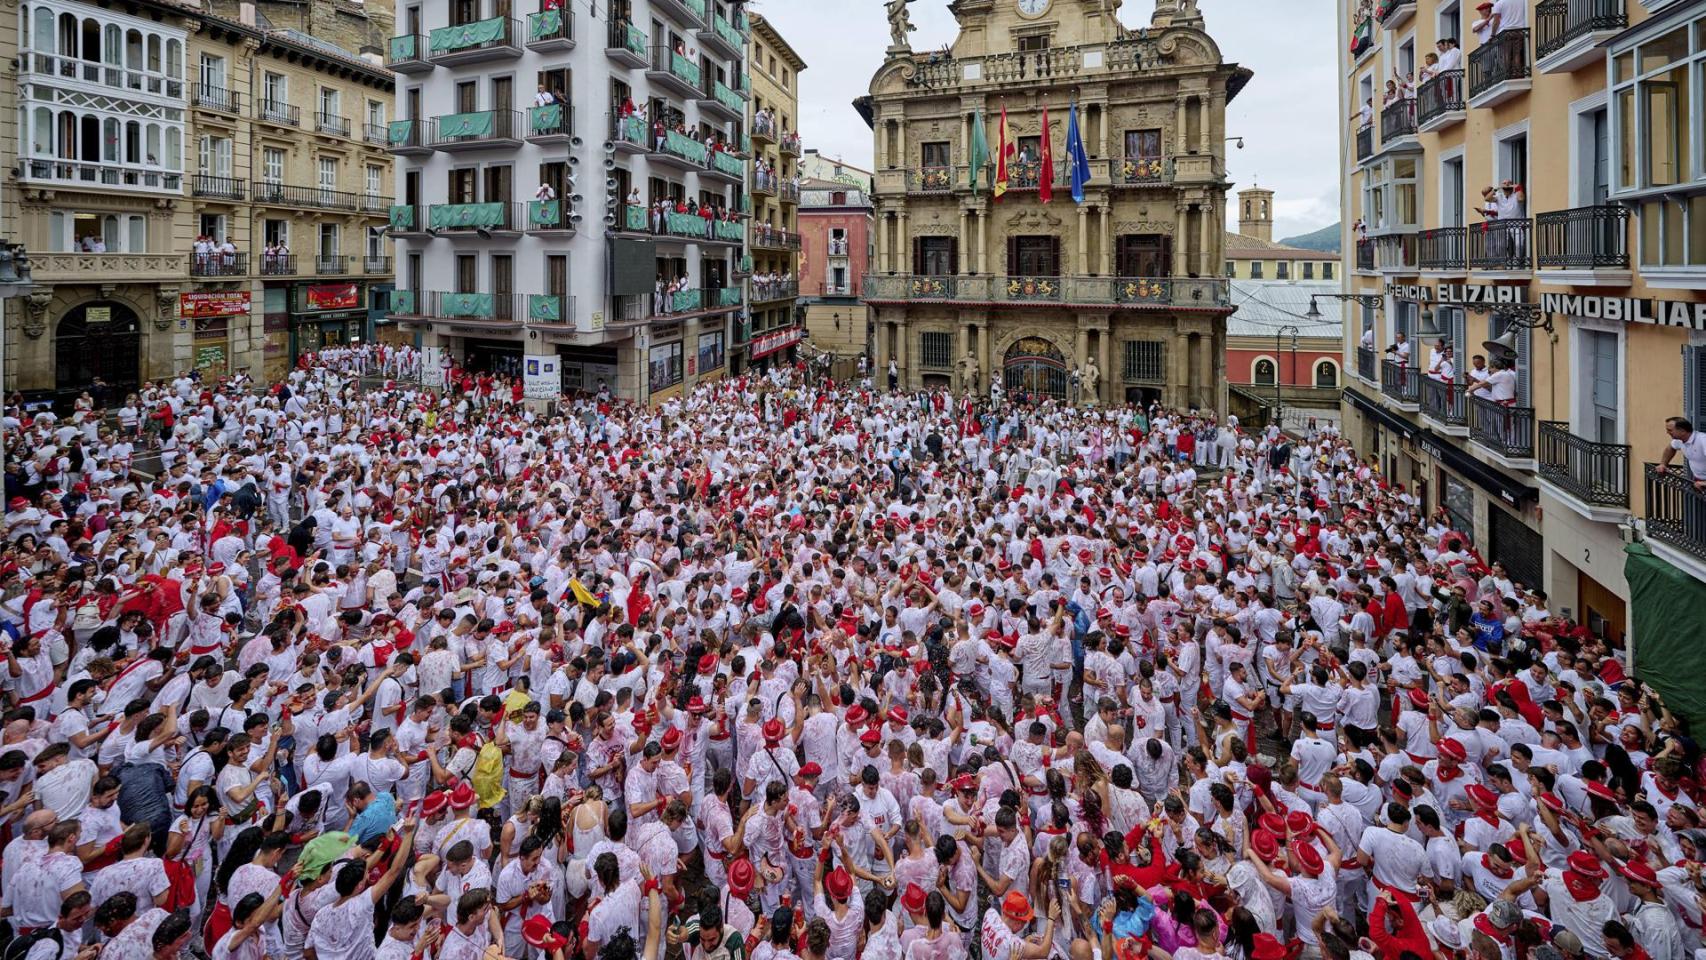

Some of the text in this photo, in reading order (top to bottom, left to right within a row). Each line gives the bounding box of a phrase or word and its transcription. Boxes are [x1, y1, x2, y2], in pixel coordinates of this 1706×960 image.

[1384, 283, 1521, 303] AGENCIA ELIZARI
[1584, 548, 1590, 564] 2
